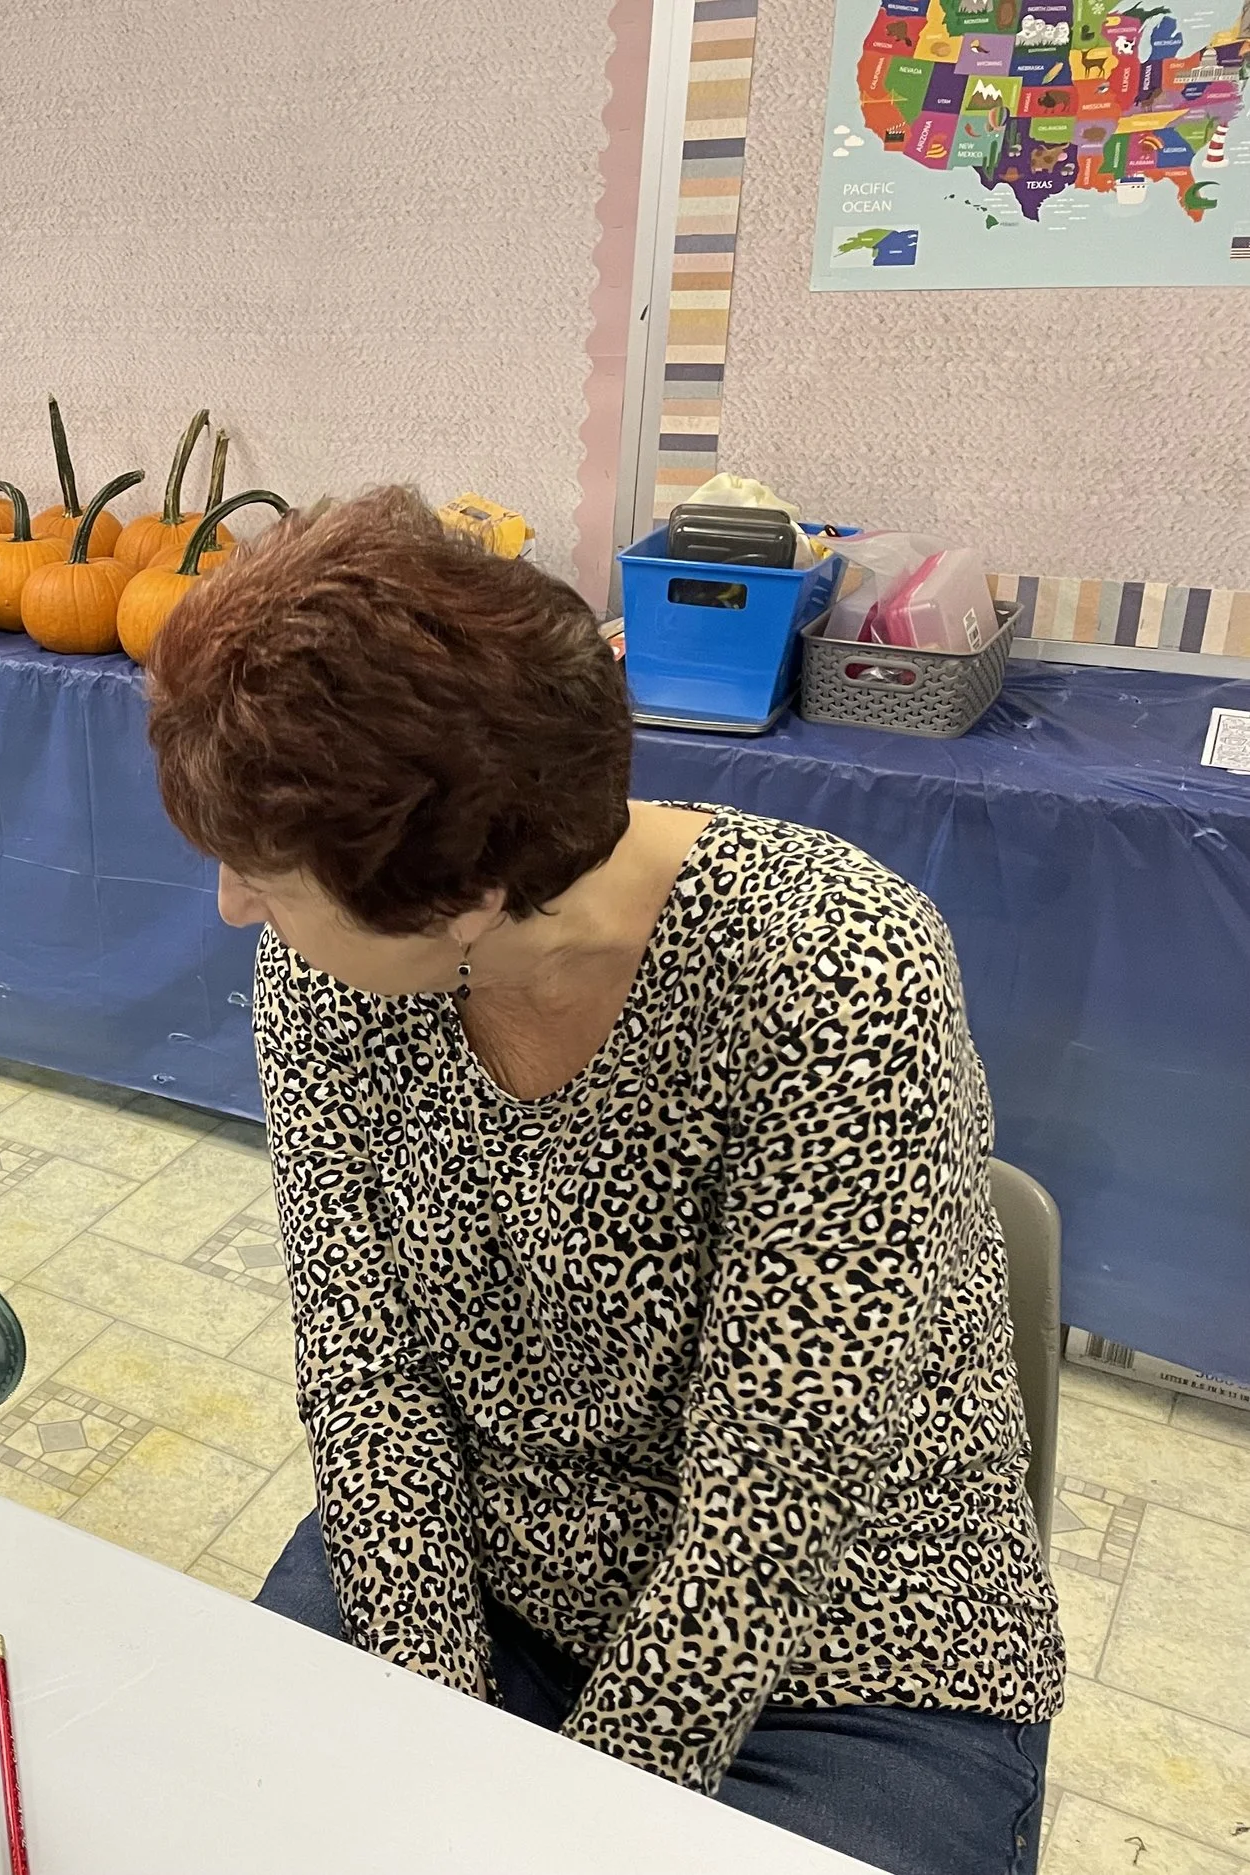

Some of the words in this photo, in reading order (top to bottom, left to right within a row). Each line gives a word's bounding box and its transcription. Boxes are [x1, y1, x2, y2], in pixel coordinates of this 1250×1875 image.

[899, 66, 922, 74] NEVADA
[916, 120, 932, 152] ARIZONA
[843, 182, 895, 195] PACIFIC
[1026, 181, 1053, 189] TEXAS
[842, 200, 892, 213] OCEAN
